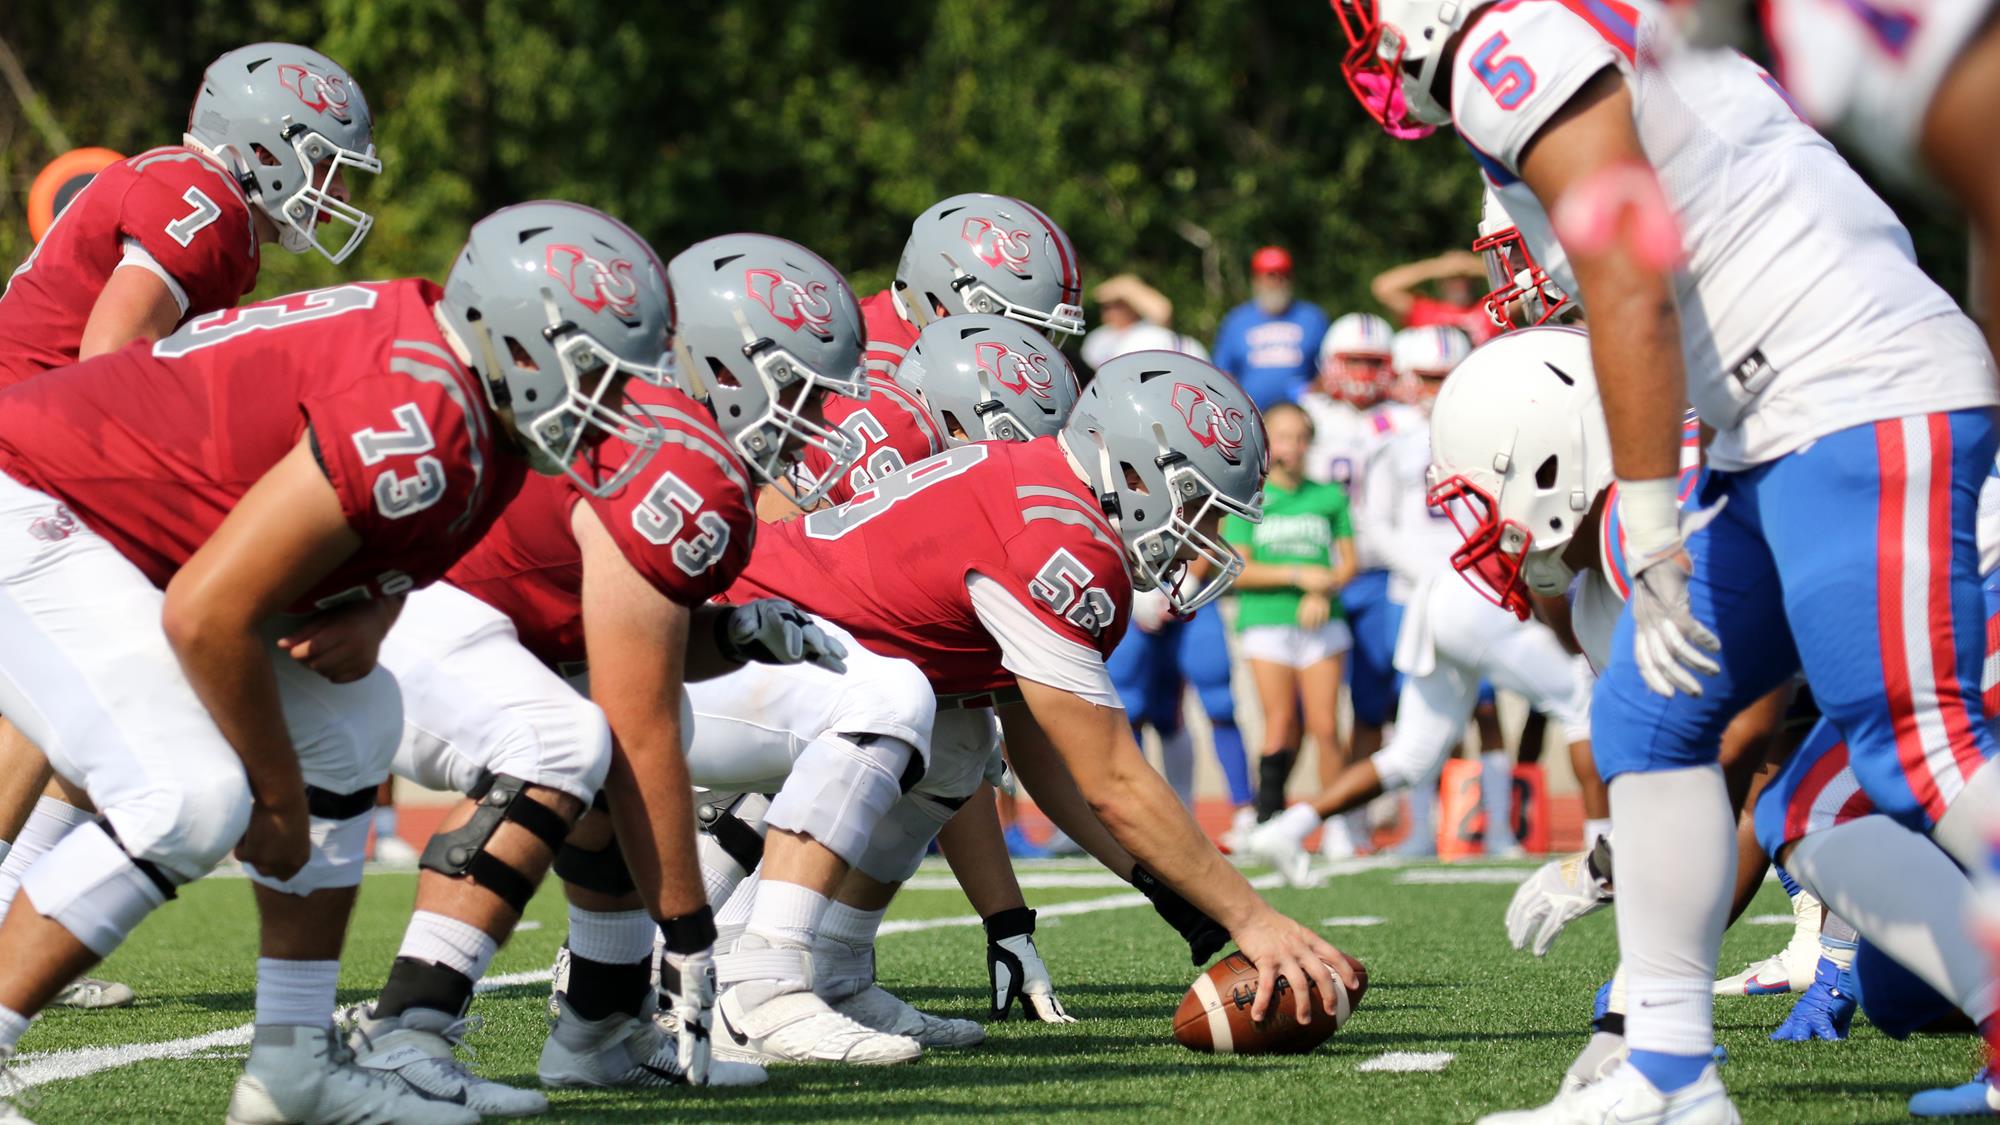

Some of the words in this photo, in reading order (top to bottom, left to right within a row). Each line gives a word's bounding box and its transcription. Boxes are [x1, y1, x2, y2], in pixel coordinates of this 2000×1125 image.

[1469, 29, 1536, 111] 5
[164, 185, 222, 248] 7
[351, 402, 447, 519] 73
[631, 470, 731, 577] 53
[1028, 546, 1116, 637] 58
